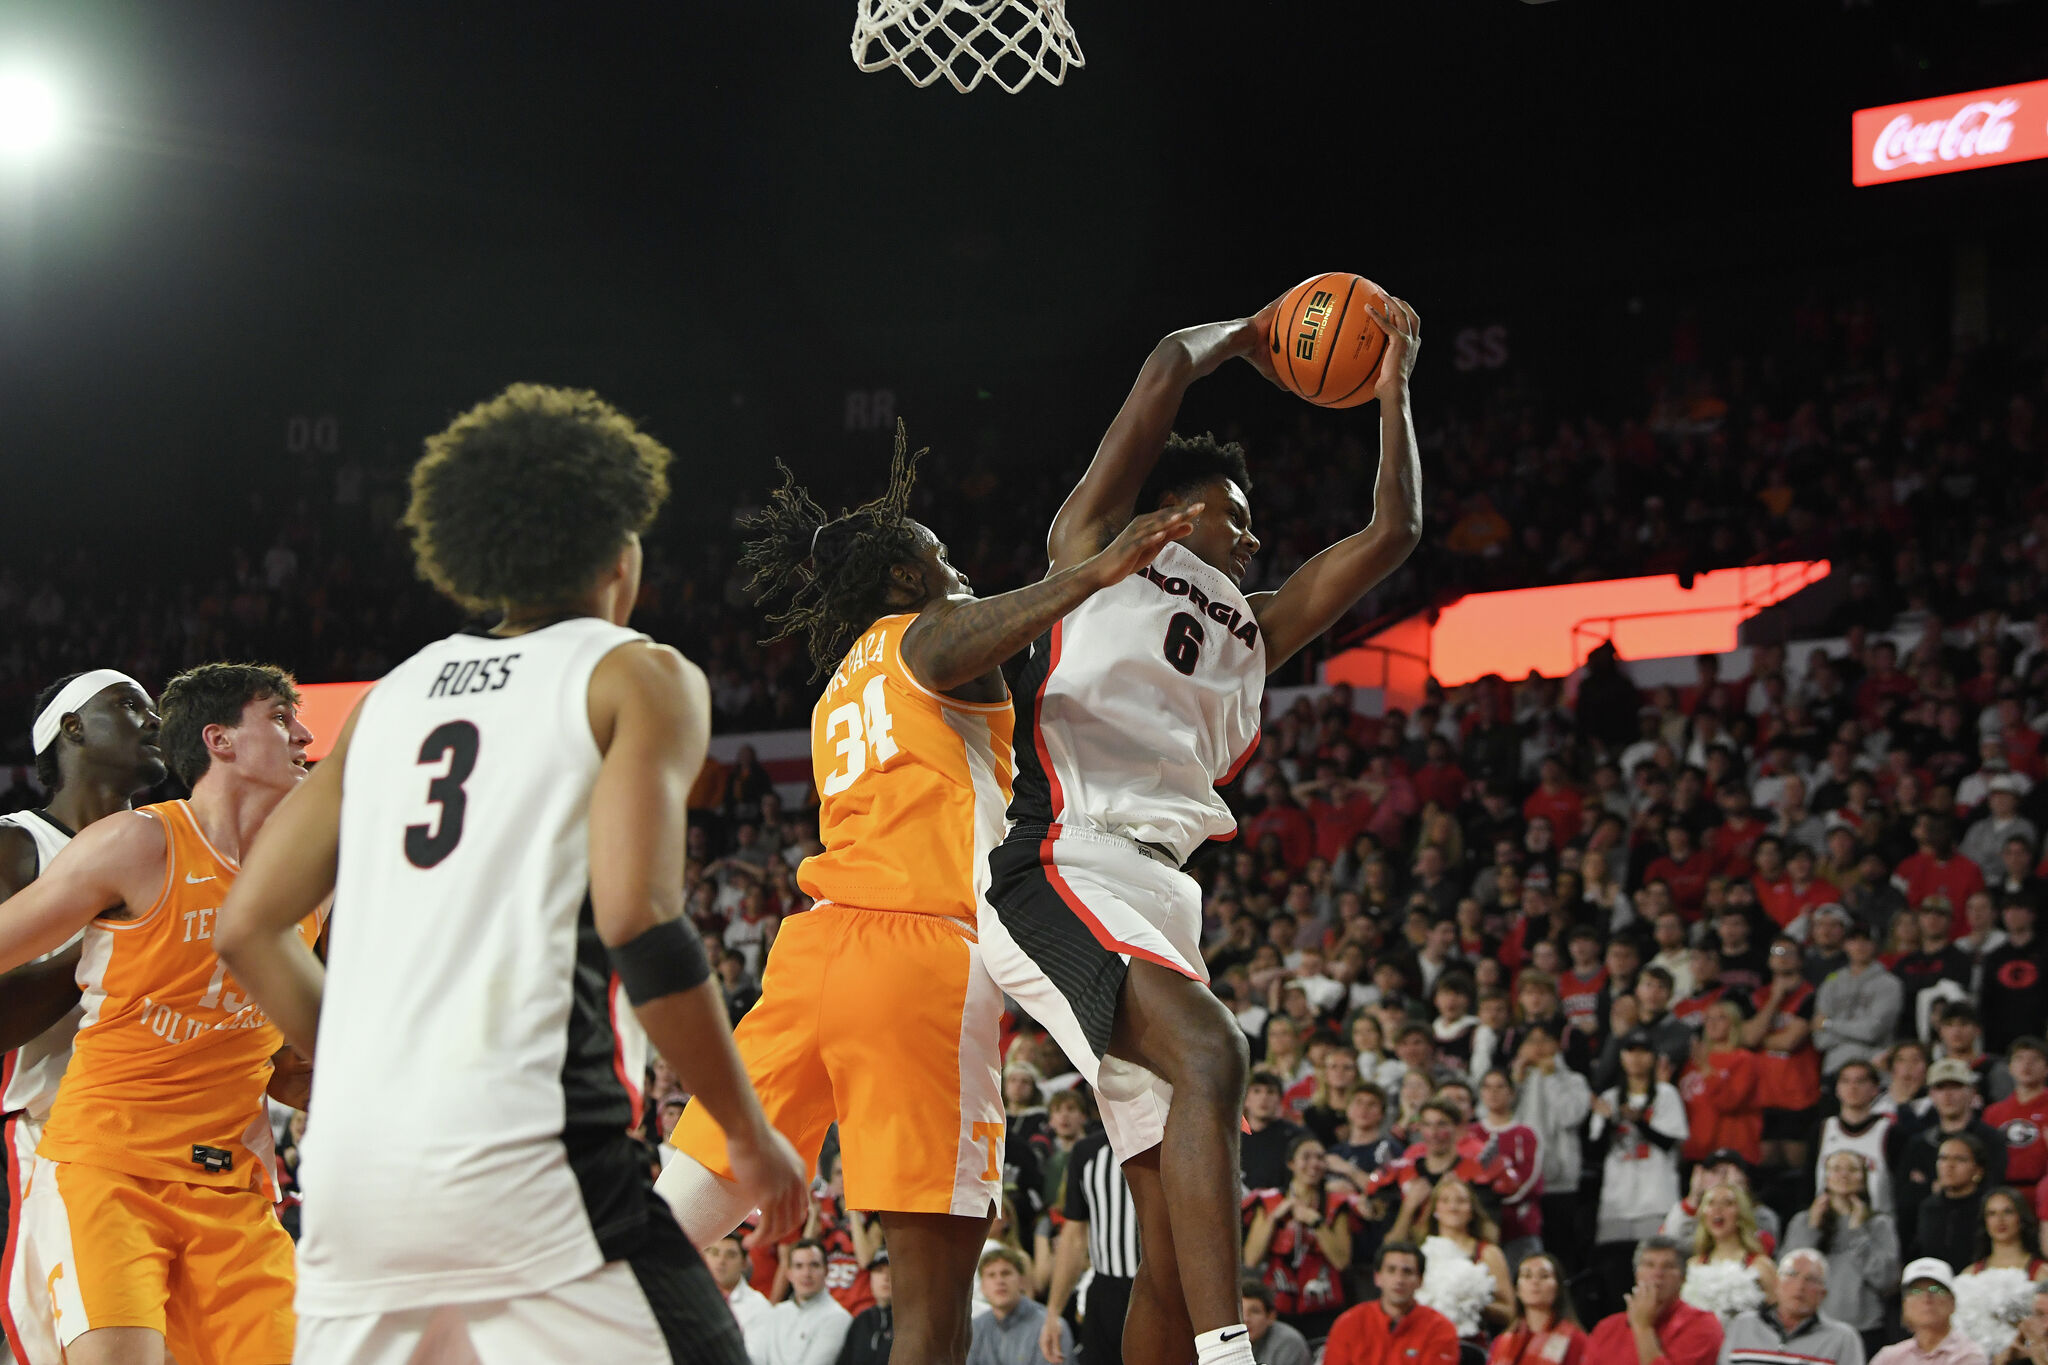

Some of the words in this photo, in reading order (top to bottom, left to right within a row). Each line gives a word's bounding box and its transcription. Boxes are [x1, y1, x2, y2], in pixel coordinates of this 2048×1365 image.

[1296, 290, 1333, 361] ELITE
[1453, 325, 1508, 371] SS
[428, 653, 521, 699] ROSS
[1163, 612, 1205, 676] 6
[823, 674, 900, 797] 34
[404, 719, 480, 869] 3
